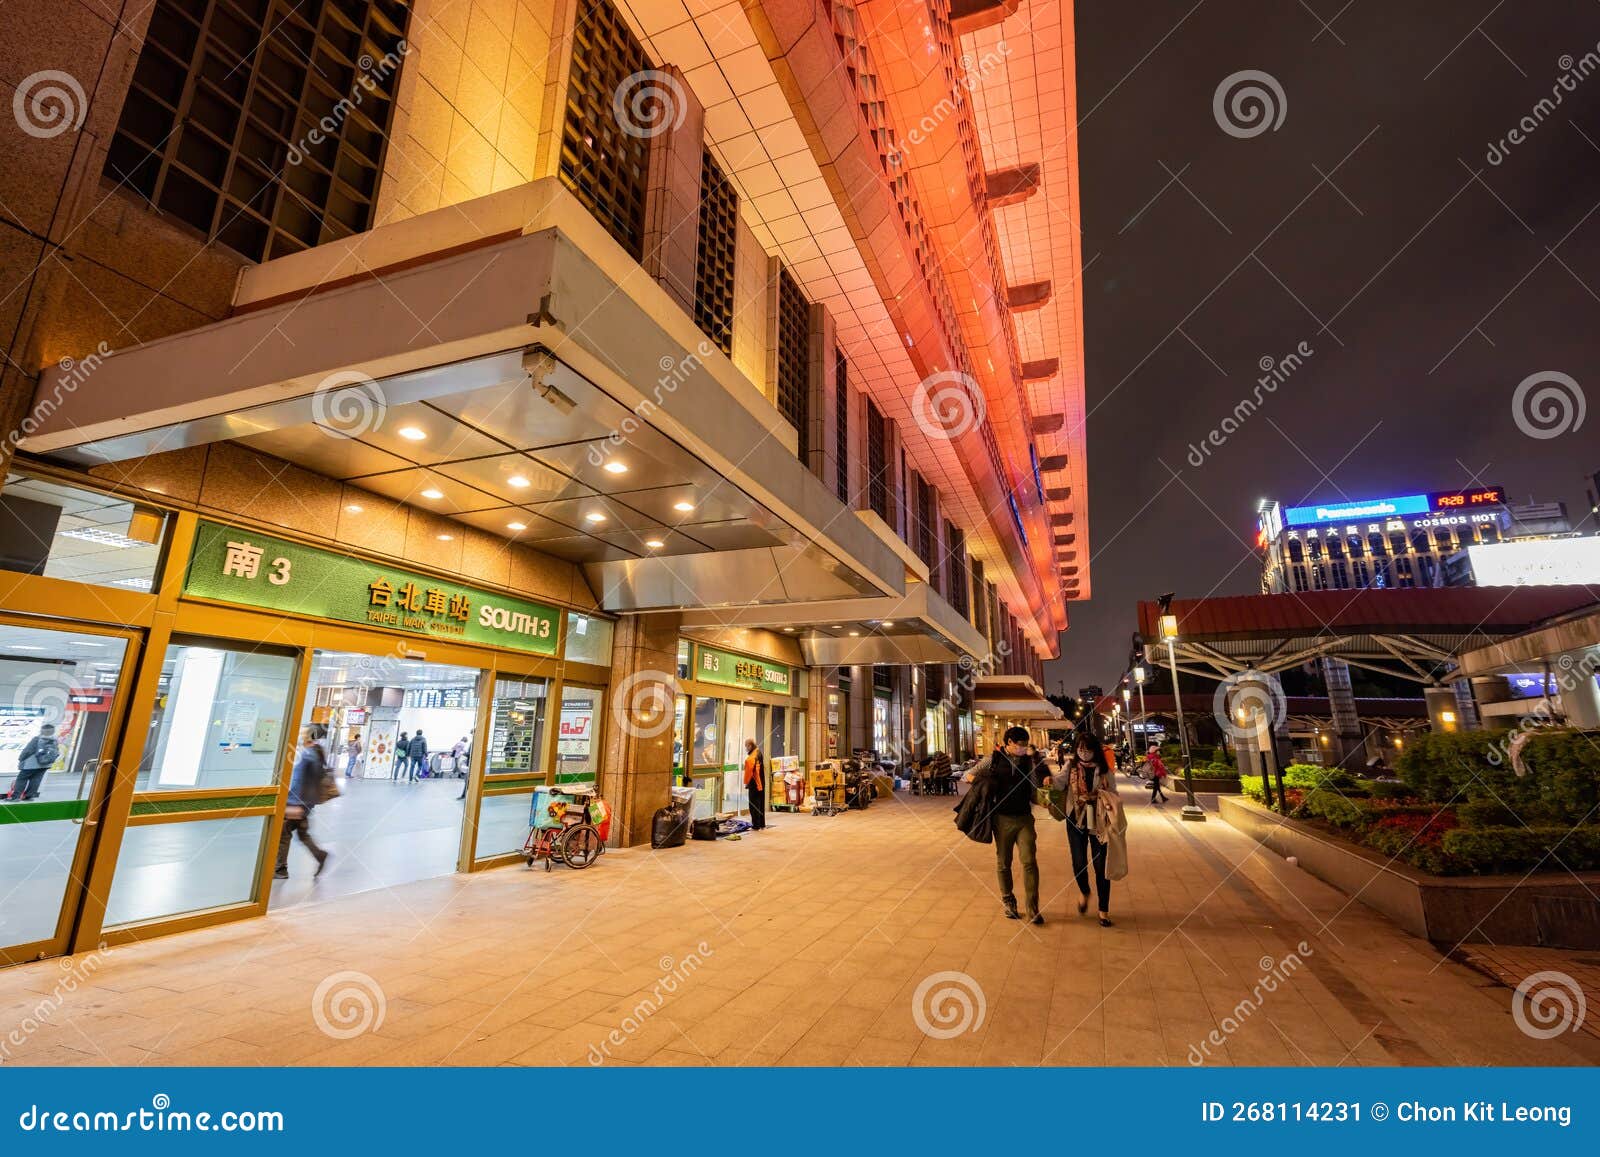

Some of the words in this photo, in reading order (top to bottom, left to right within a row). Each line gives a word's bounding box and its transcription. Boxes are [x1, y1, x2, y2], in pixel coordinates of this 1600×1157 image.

[1414, 516, 1467, 528] COSMOS
[1472, 513, 1499, 523] HOT
[368, 576, 472, 622] 台北車站
[367, 610, 398, 626] TAIPEI
